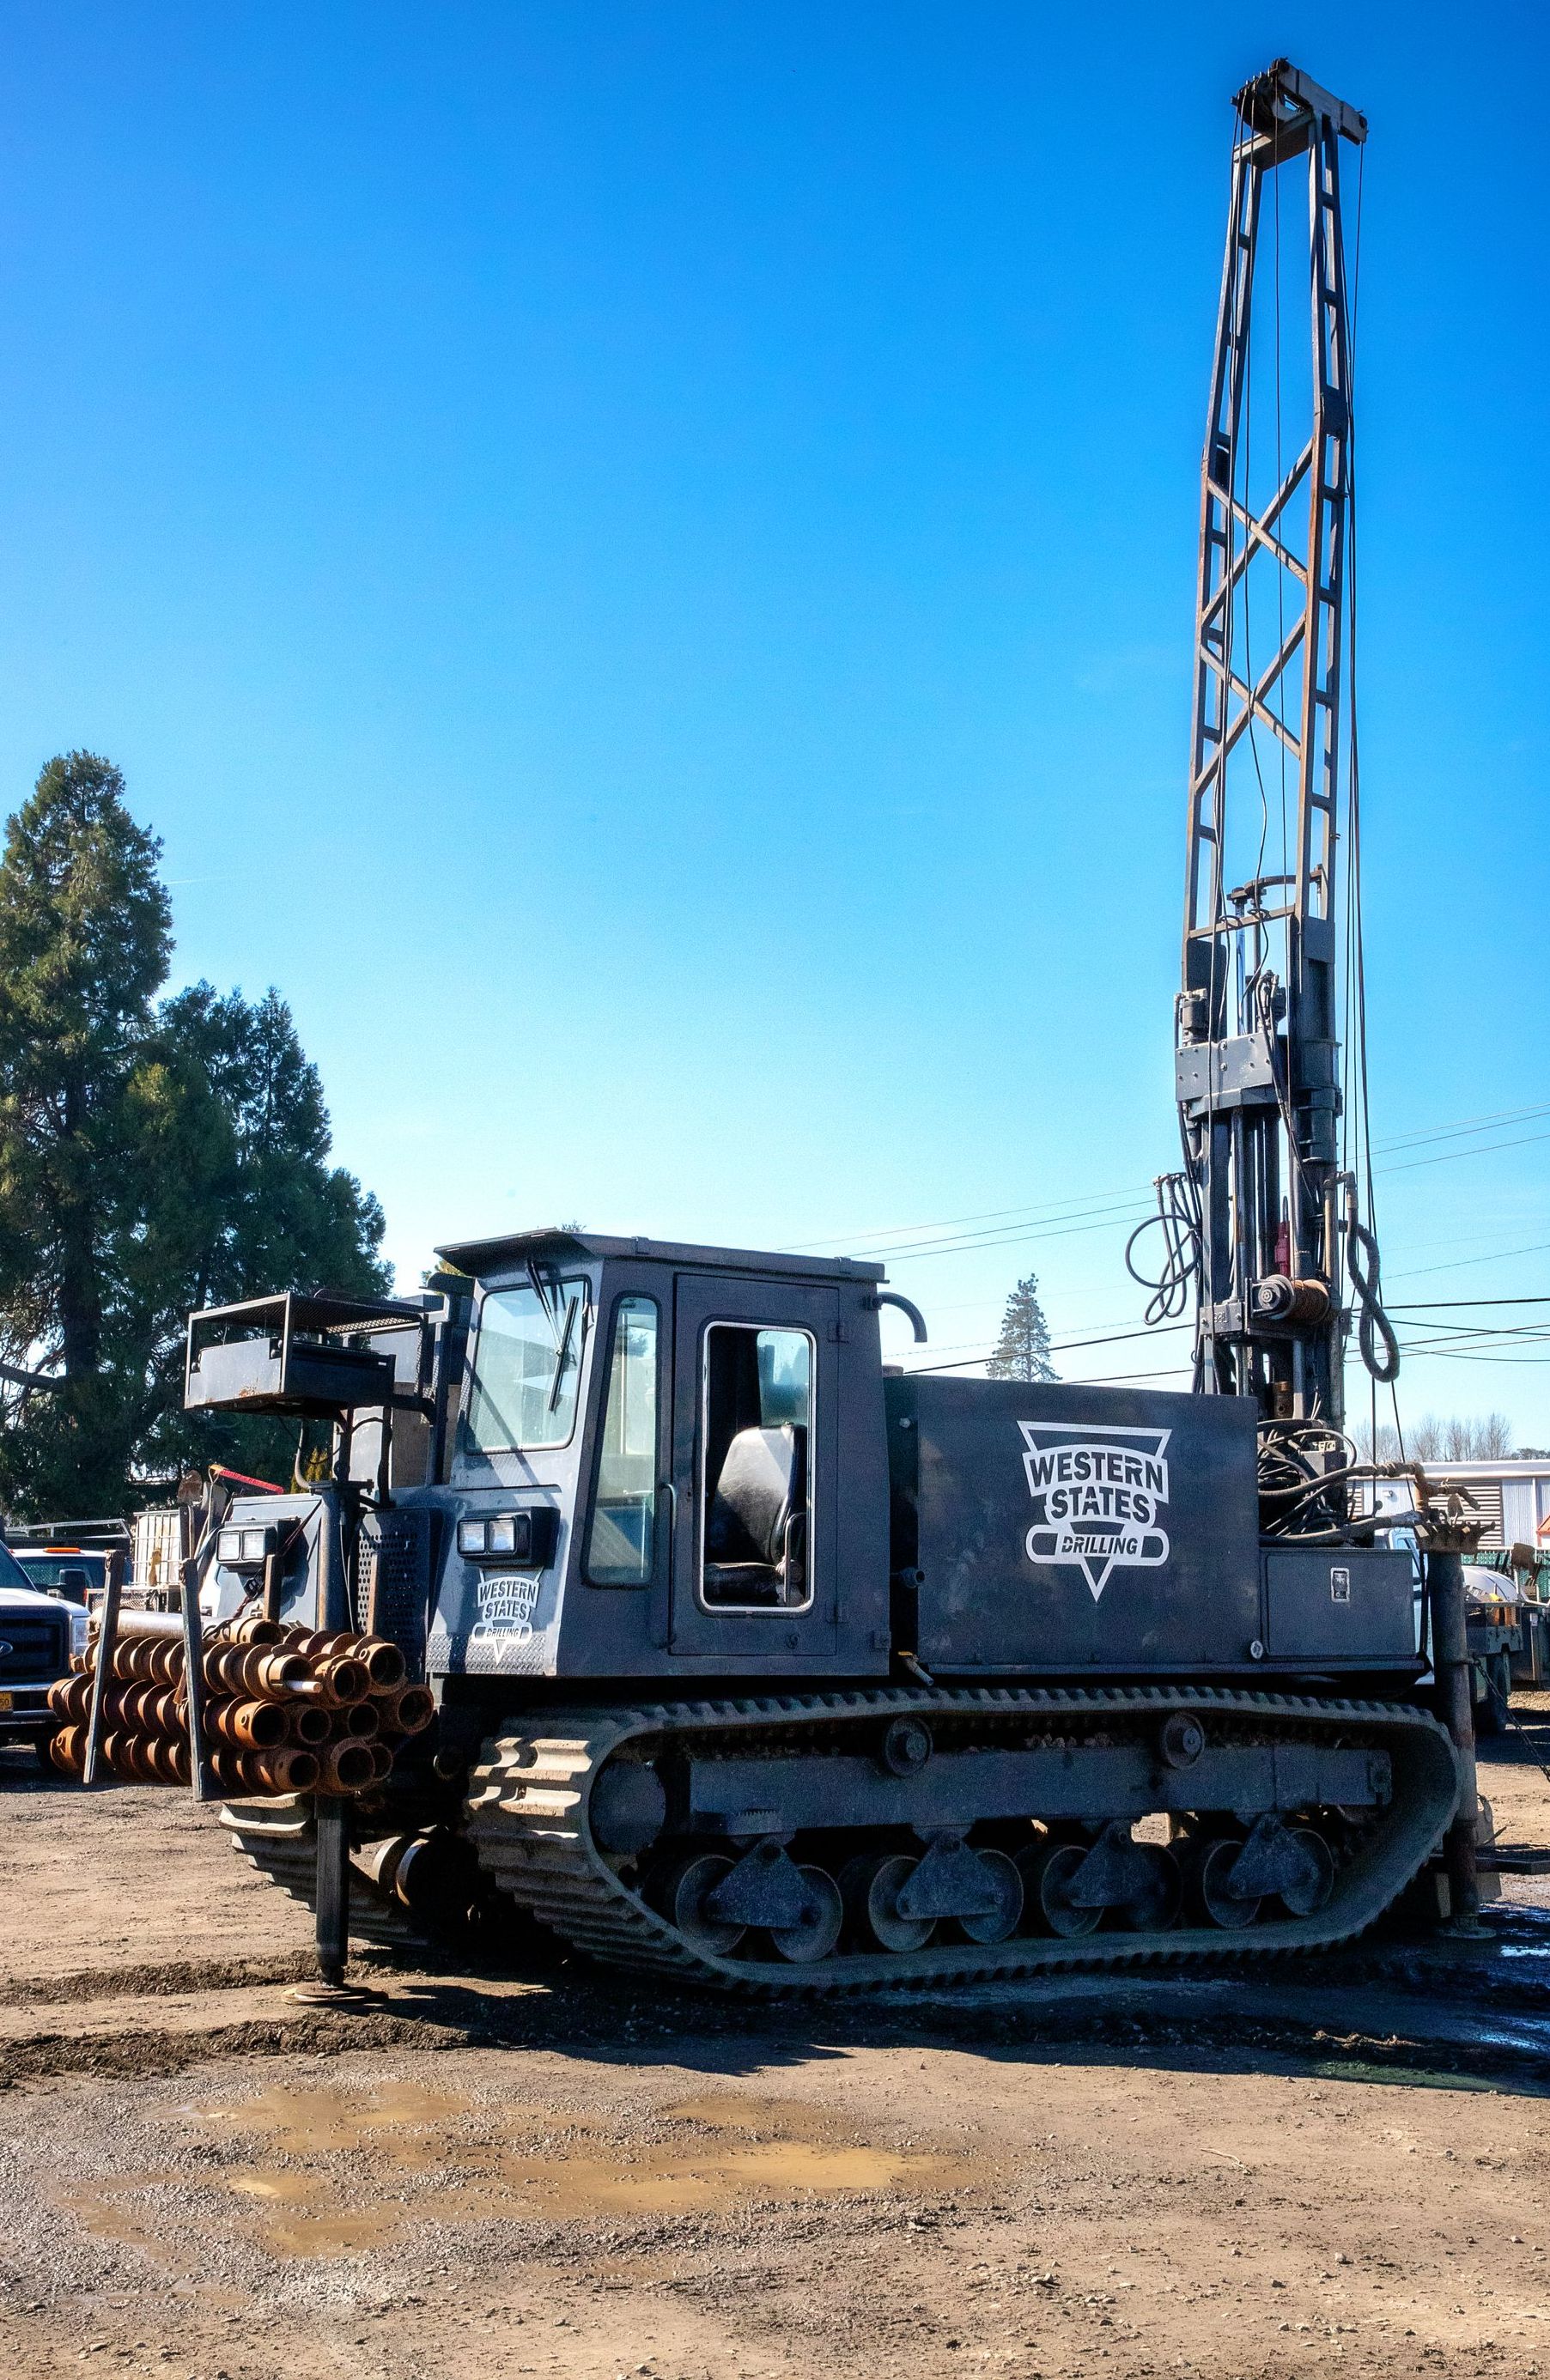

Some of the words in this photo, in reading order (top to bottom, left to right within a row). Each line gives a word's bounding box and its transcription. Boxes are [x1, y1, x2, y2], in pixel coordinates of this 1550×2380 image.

[1029, 1451, 1163, 1493] WESTERN
[1050, 1486, 1150, 1523] STATES
[1061, 1536, 1138, 1555] DRILLING
[480, 1581, 537, 1603] WESTERN
[484, 1600, 526, 1620] STATES
[486, 1628, 519, 1637] DRILLING
